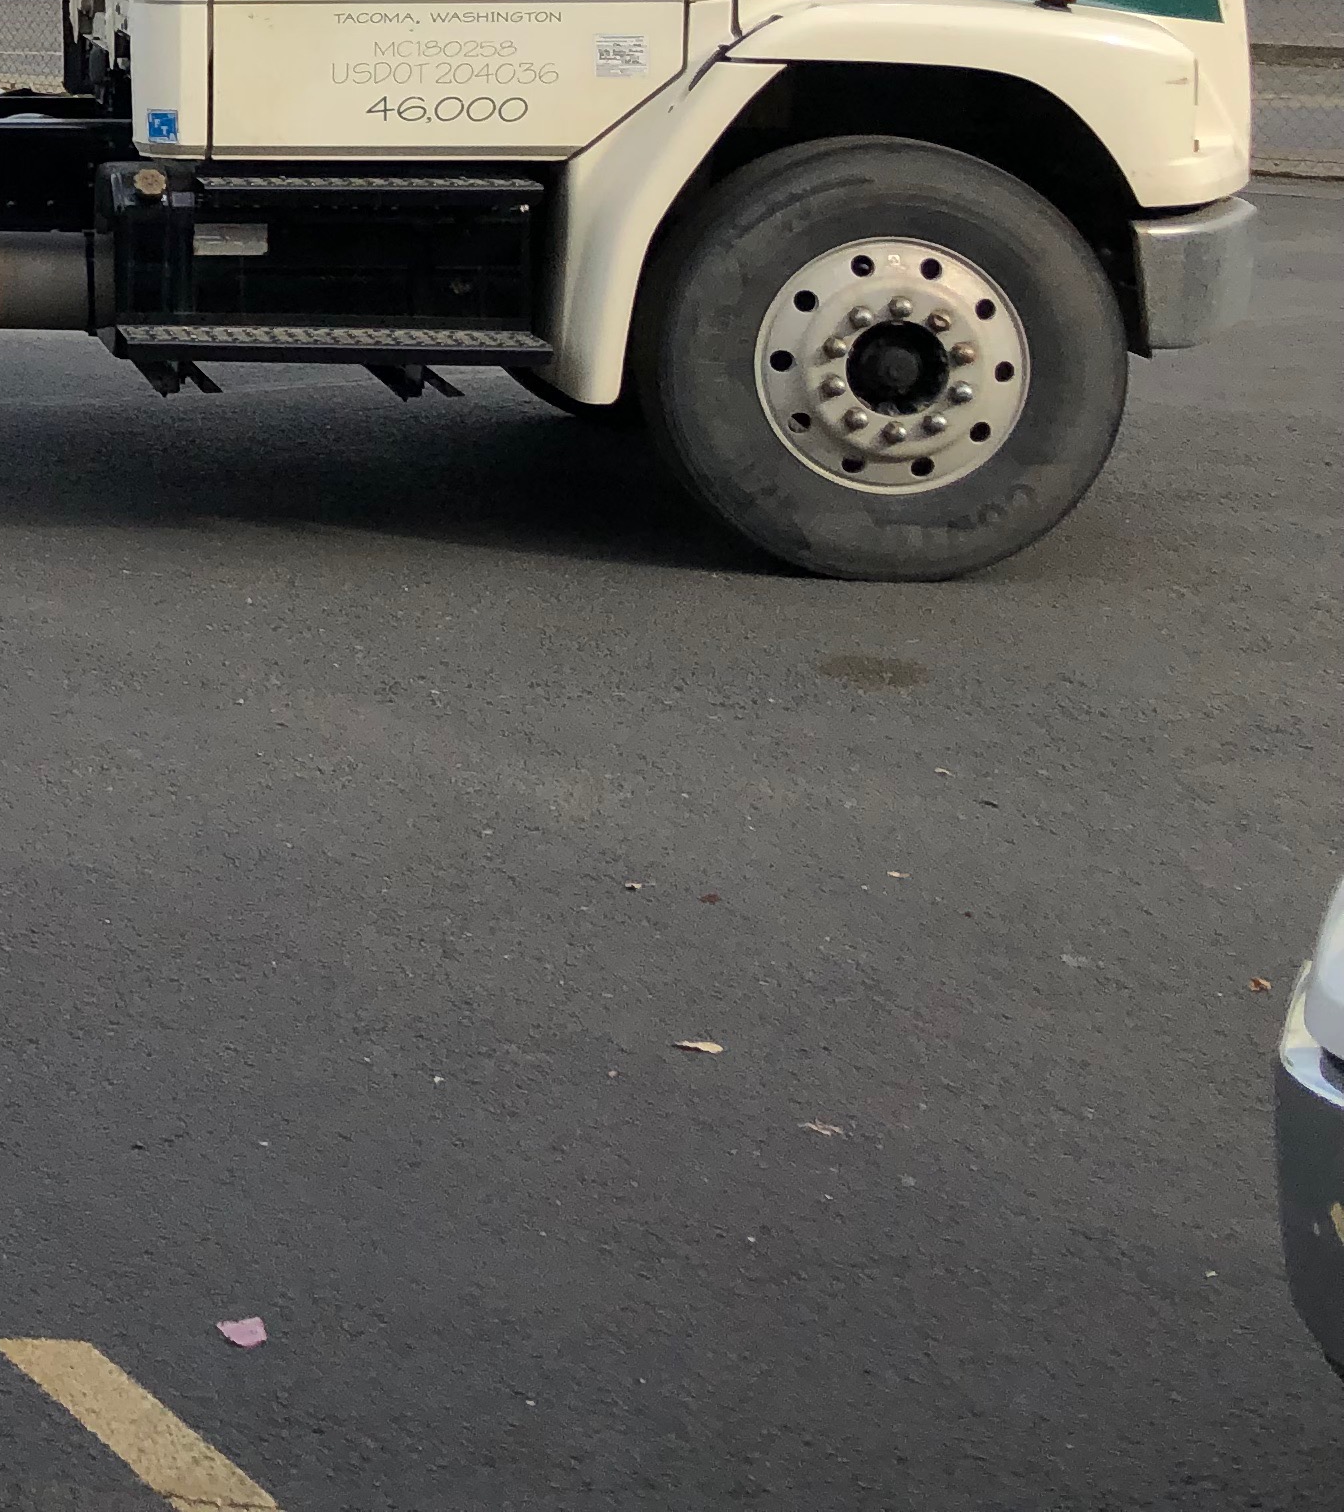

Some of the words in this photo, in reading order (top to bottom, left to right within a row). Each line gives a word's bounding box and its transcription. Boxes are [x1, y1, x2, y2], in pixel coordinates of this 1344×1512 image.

[429, 11, 563, 24] WASHINGTON
[373, 40, 518, 58] MC180258
[331, 61, 430, 85] USDOT
[435, 62, 560, 85] 204036
[365, 95, 529, 124] 46,000
